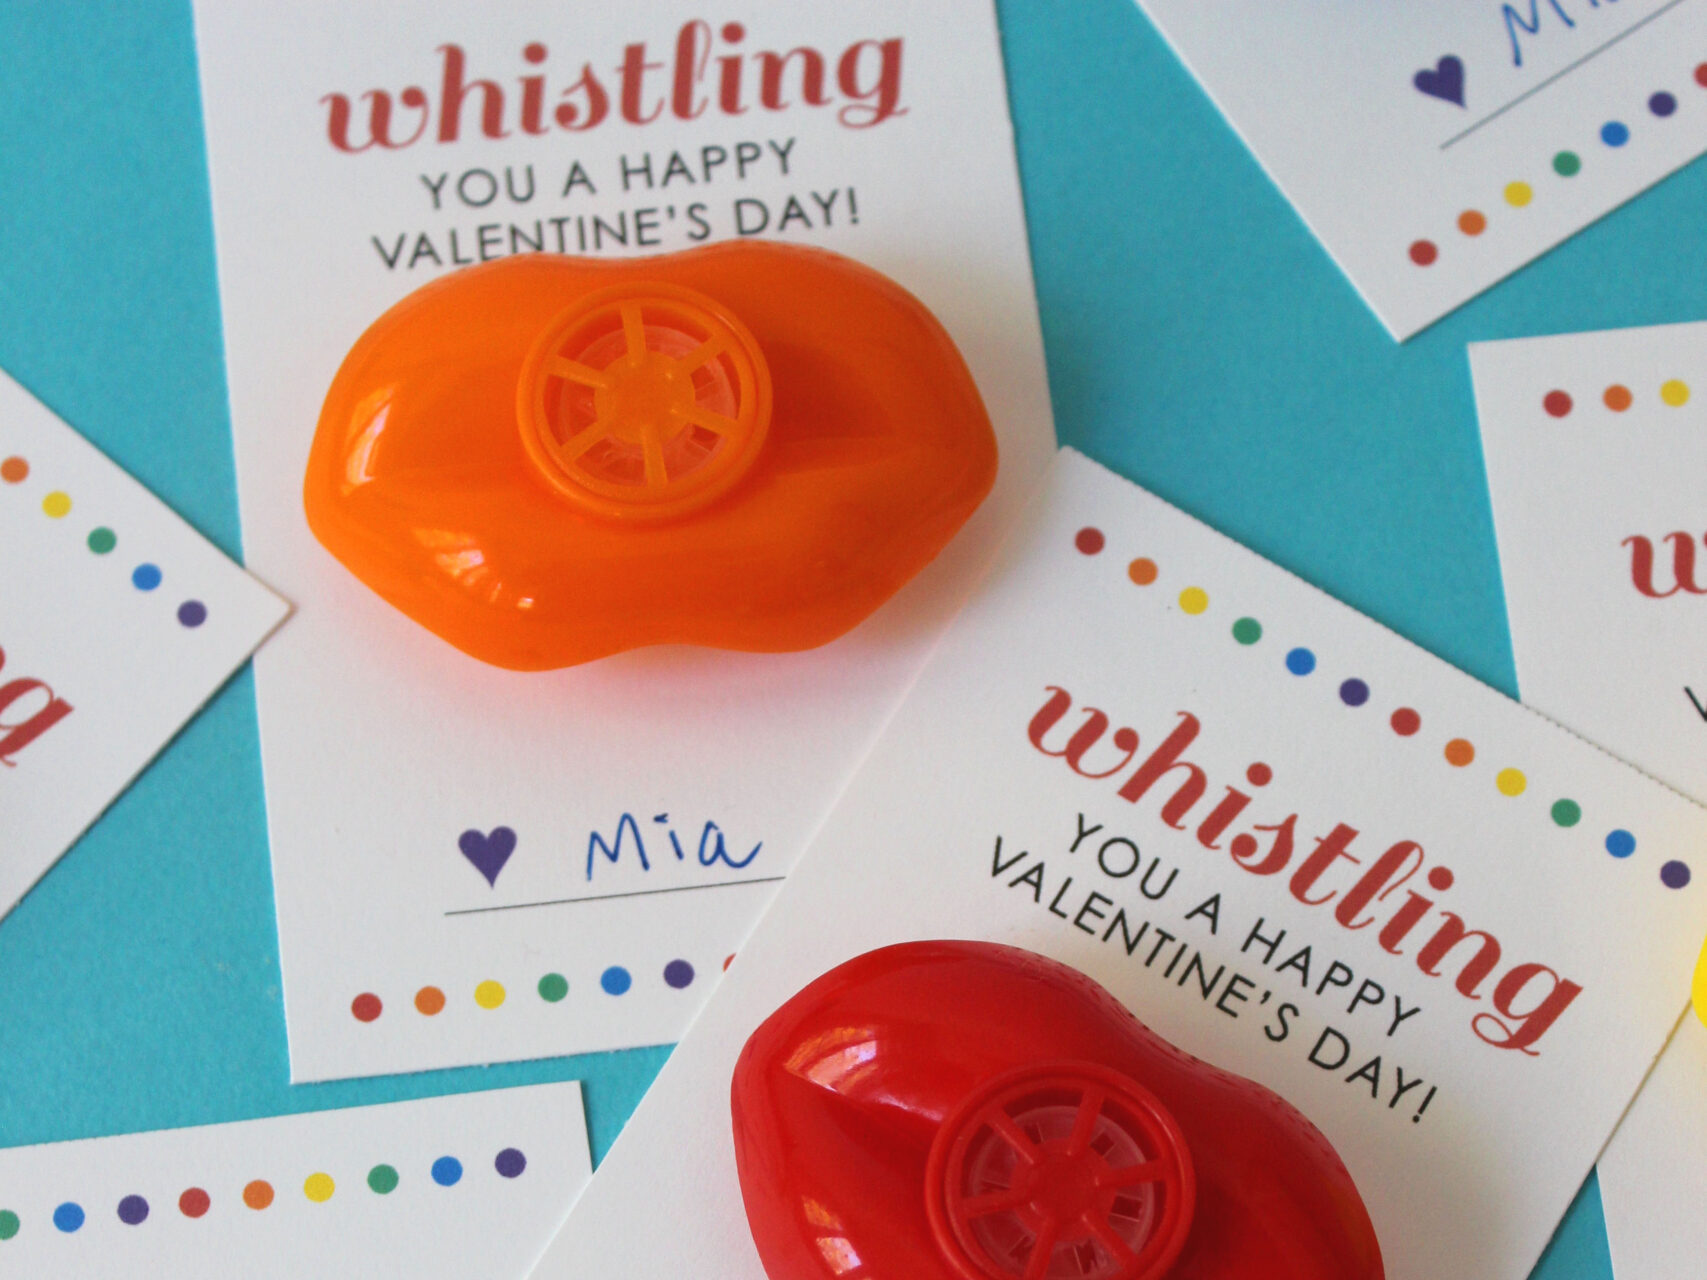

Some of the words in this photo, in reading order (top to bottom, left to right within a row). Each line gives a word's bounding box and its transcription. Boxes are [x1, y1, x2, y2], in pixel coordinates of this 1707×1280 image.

[318, 19, 910, 153] whistling
[370, 201, 713, 271] VALENTINE'S
[733, 186, 861, 237] DAY!
[419, 164, 537, 211] YOU
[561, 160, 598, 198] A
[620, 137, 797, 191] HAPPY
[585, 812, 763, 882] Mia
[1027, 685, 1584, 1057] whistling
[991, 835, 1300, 1043] VALENTINE'S
[1307, 1027, 1438, 1124] DAY!
[1068, 812, 1180, 901] YOU
[1184, 893, 1223, 936] A
[1240, 917, 1421, 1038] HAPPY
